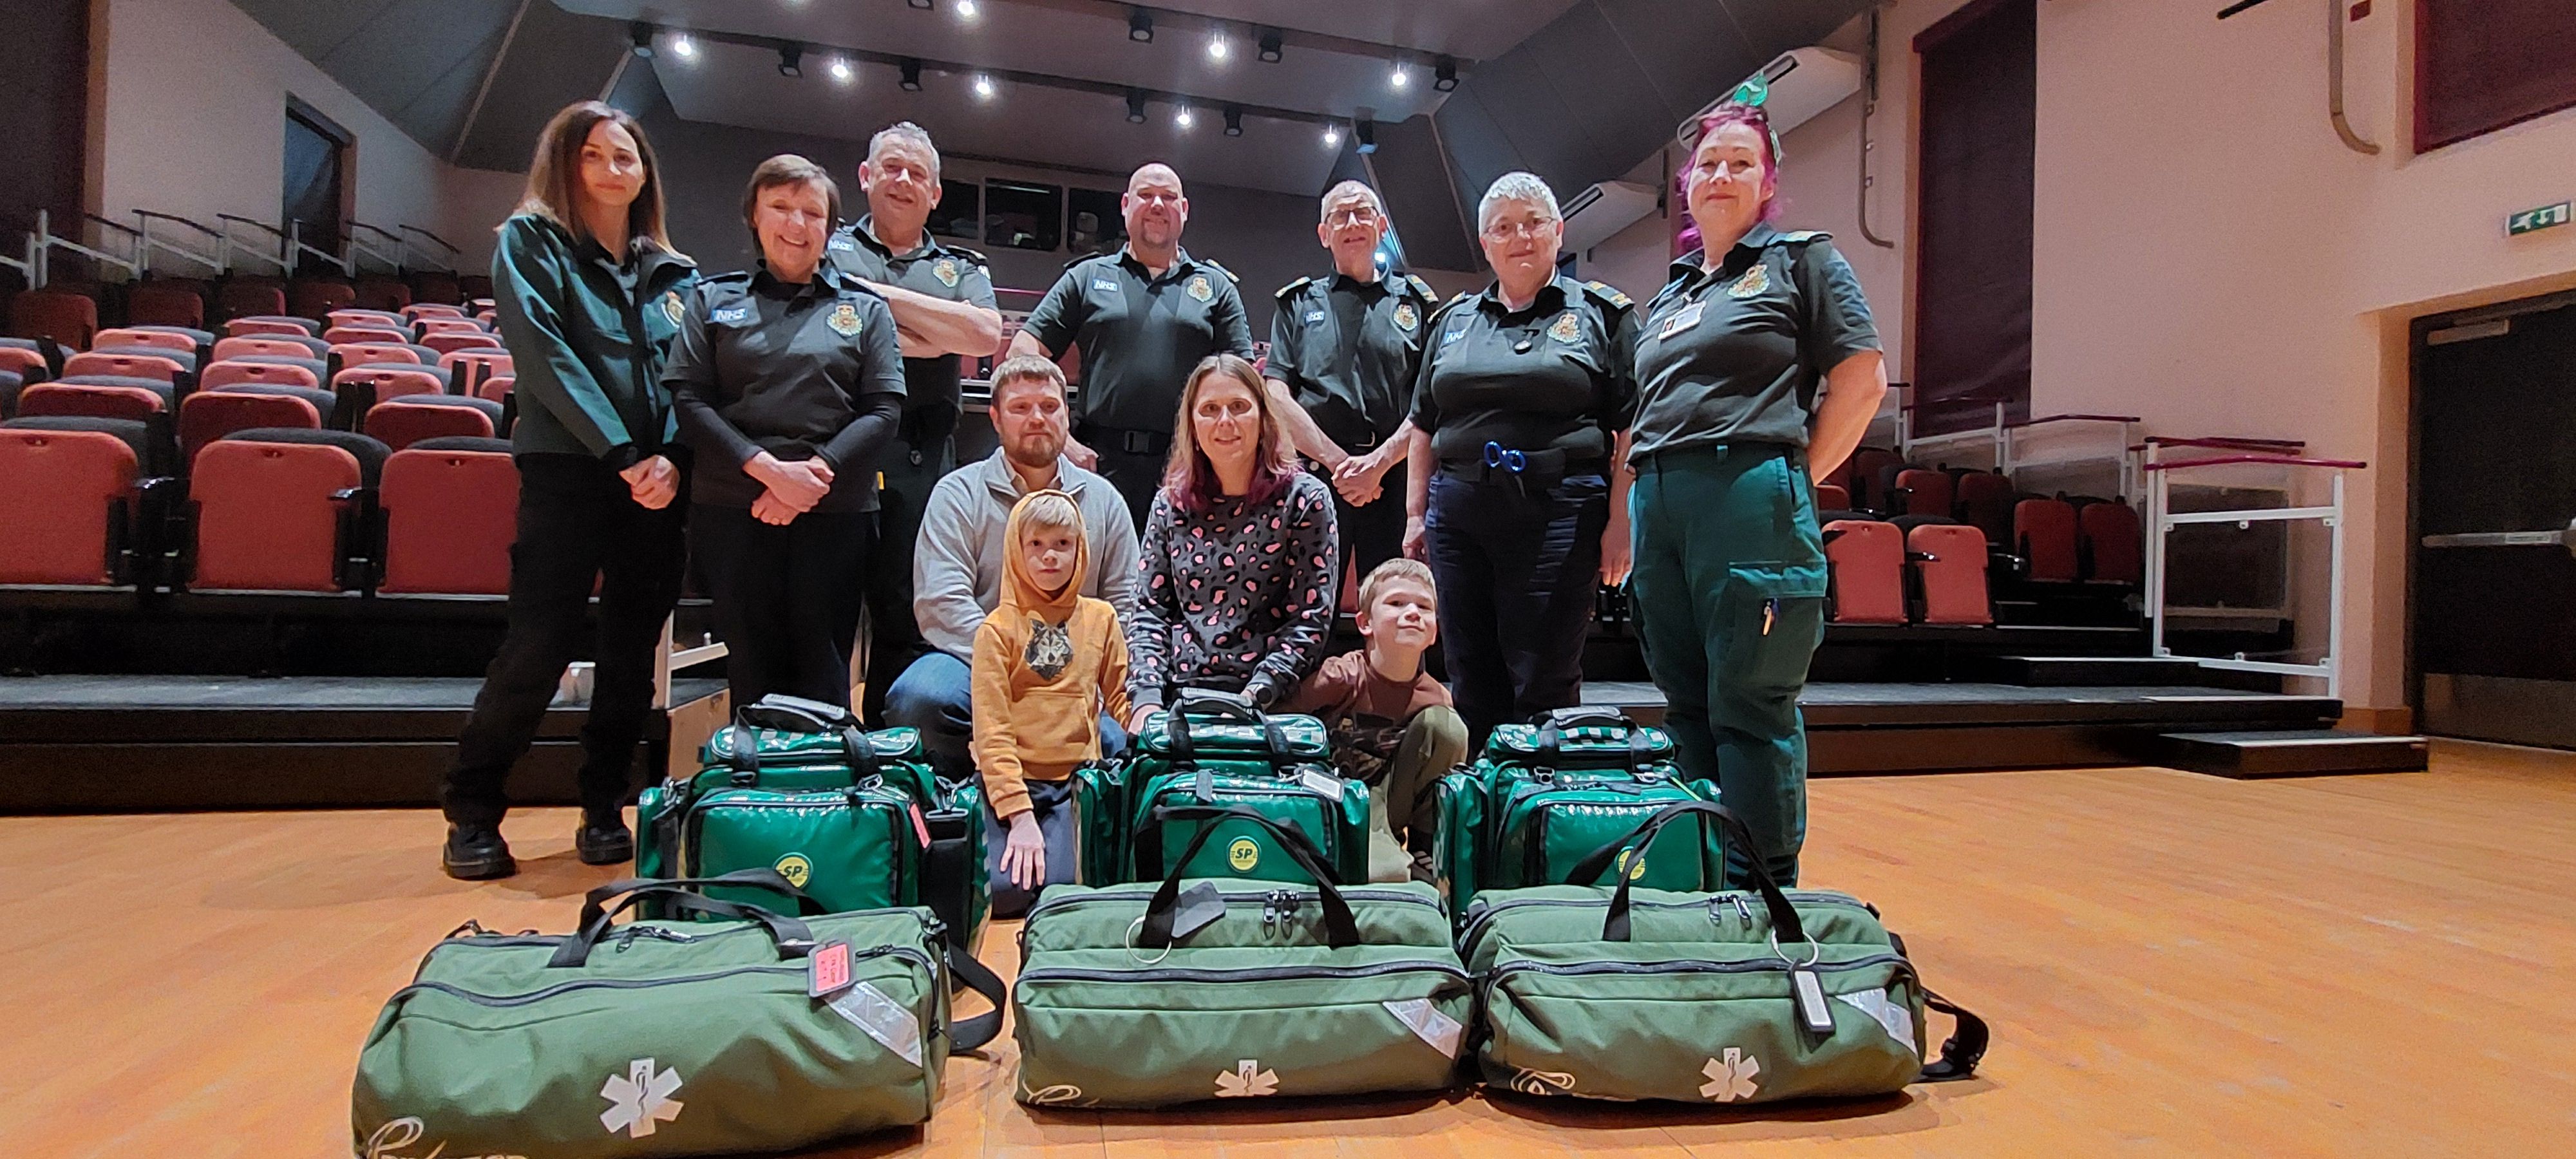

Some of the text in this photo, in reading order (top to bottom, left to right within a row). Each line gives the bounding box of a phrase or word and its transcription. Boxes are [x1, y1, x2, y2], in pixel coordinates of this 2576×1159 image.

[828, 239, 853, 250] NHS
[1093, 279, 1118, 291] NHS
[714, 308, 747, 322] NHS
[1235, 847, 1253, 860] SP
[784, 865, 803, 878] SP
